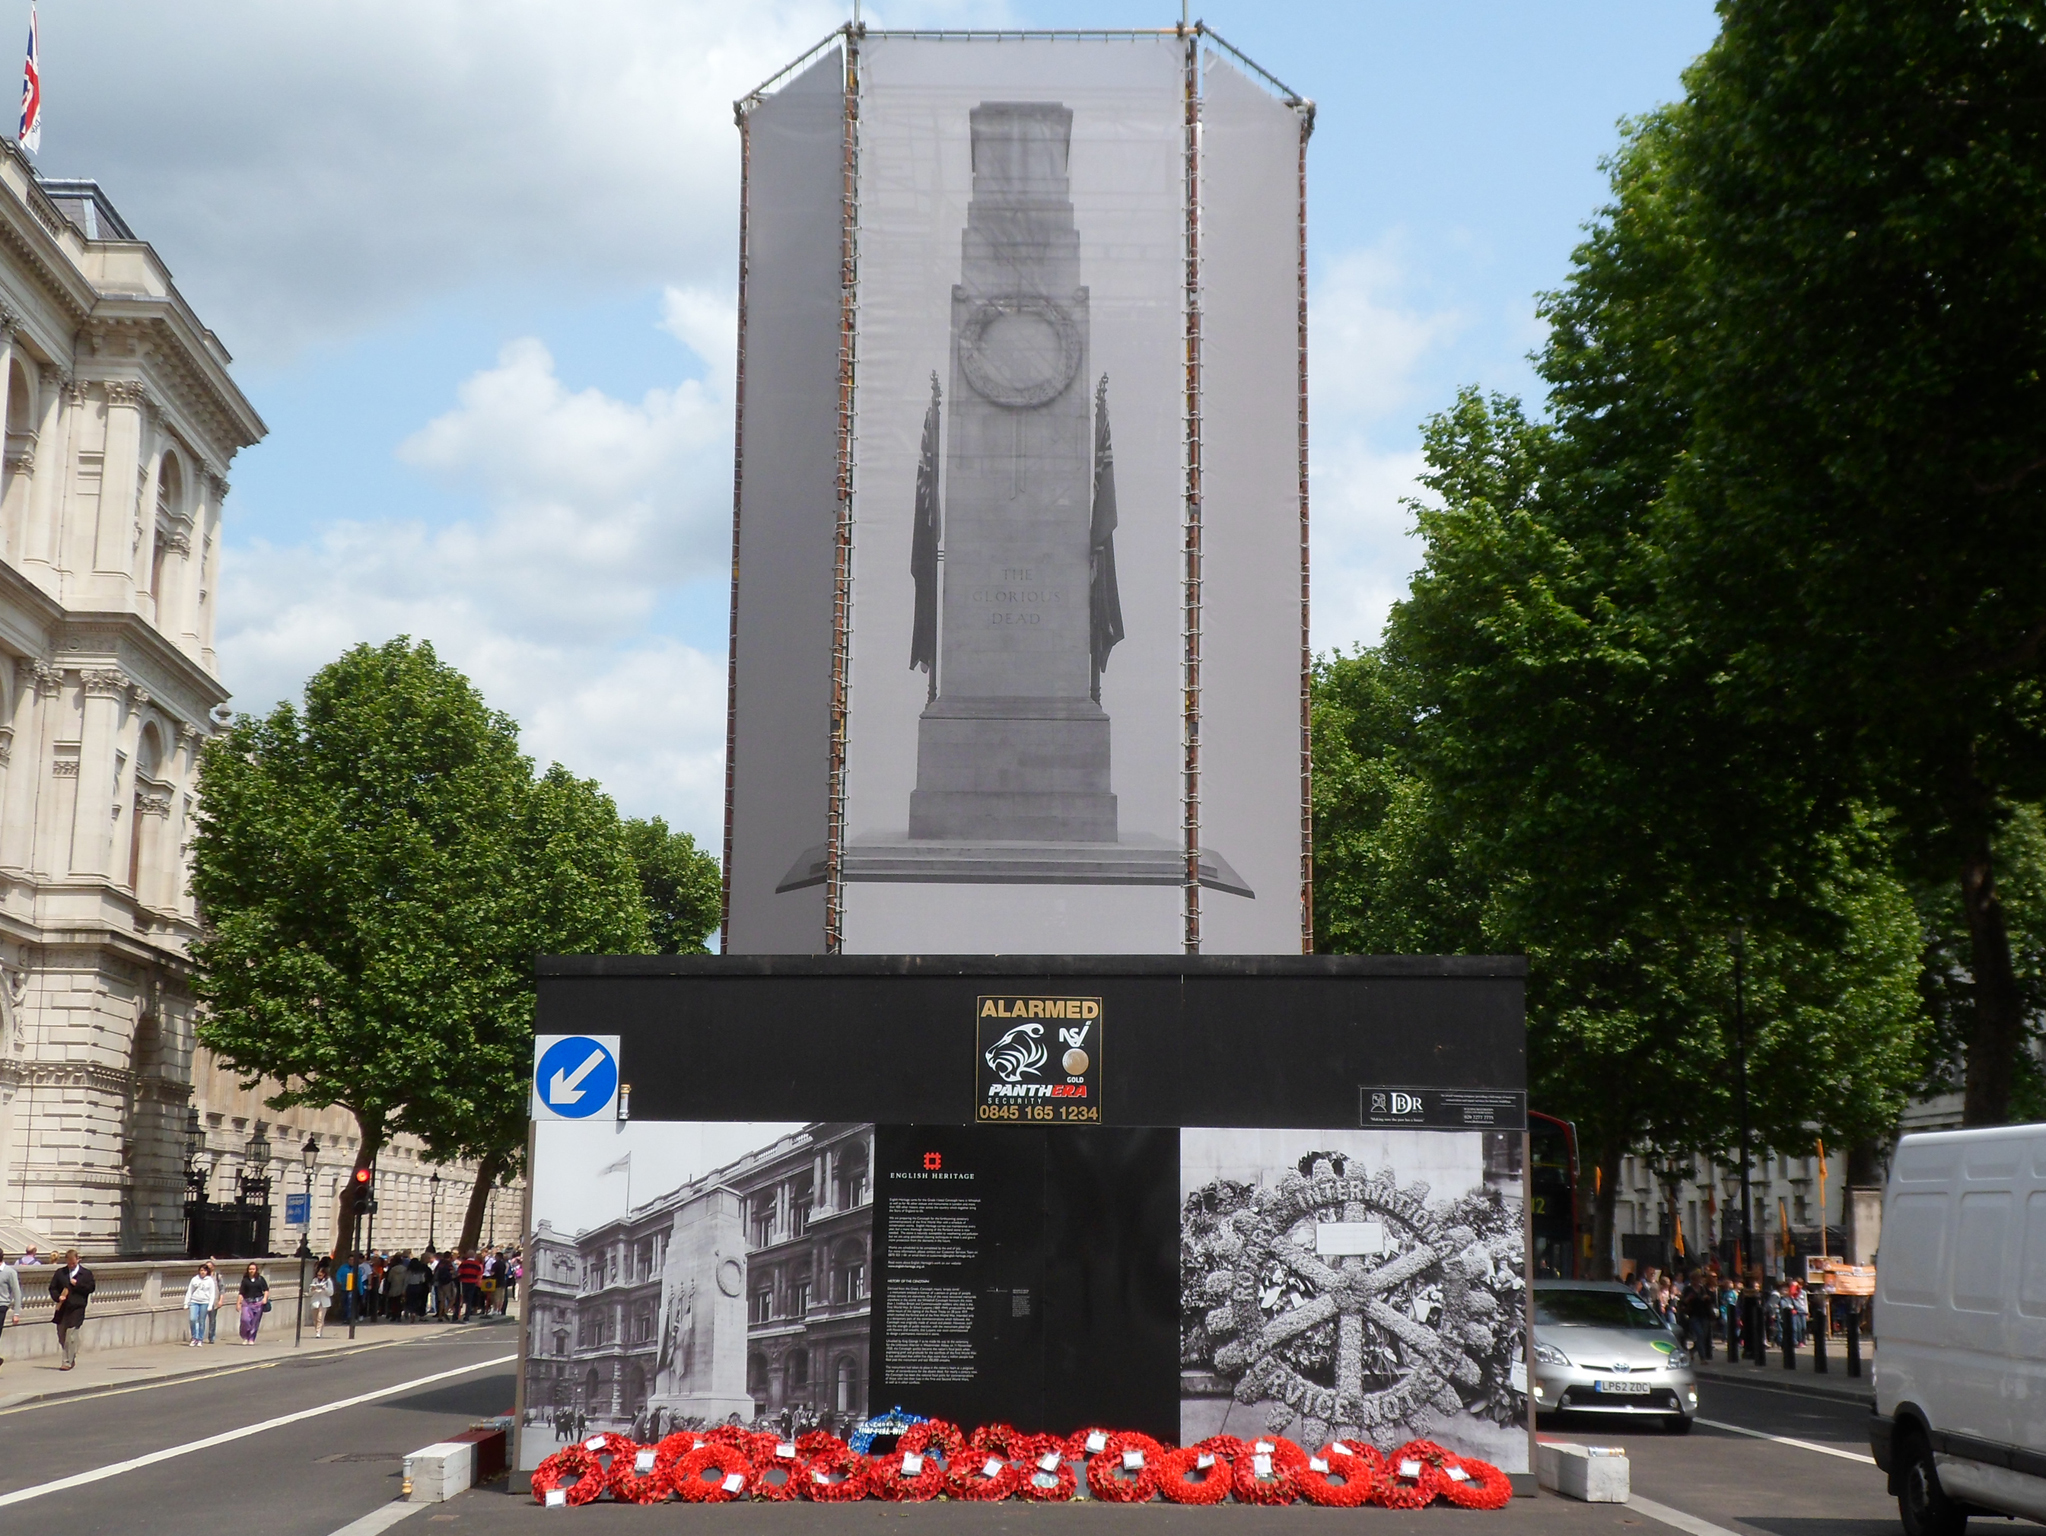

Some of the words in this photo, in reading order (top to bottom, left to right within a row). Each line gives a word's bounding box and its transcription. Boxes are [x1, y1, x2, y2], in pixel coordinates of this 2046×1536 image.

[1001, 568, 1033, 581] THE
[972, 591, 1061, 603] GLORIOUS
[992, 613, 1041, 625] DEAD
[980, 1000, 1099, 1019] ALARMED
[1066, 1076, 1085, 1084] GOLD
[988, 1084, 1087, 1098] PANTHERA
[987, 1097, 1042, 1105] SECURITY
[980, 1105, 1019, 1119] 0845
[1025, 1106, 1054, 1120] 165
[1060, 1106, 1099, 1120] 1234
[1602, 1381, 1628, 1392] LP62
[1630, 1382, 1649, 1393] ZDC
